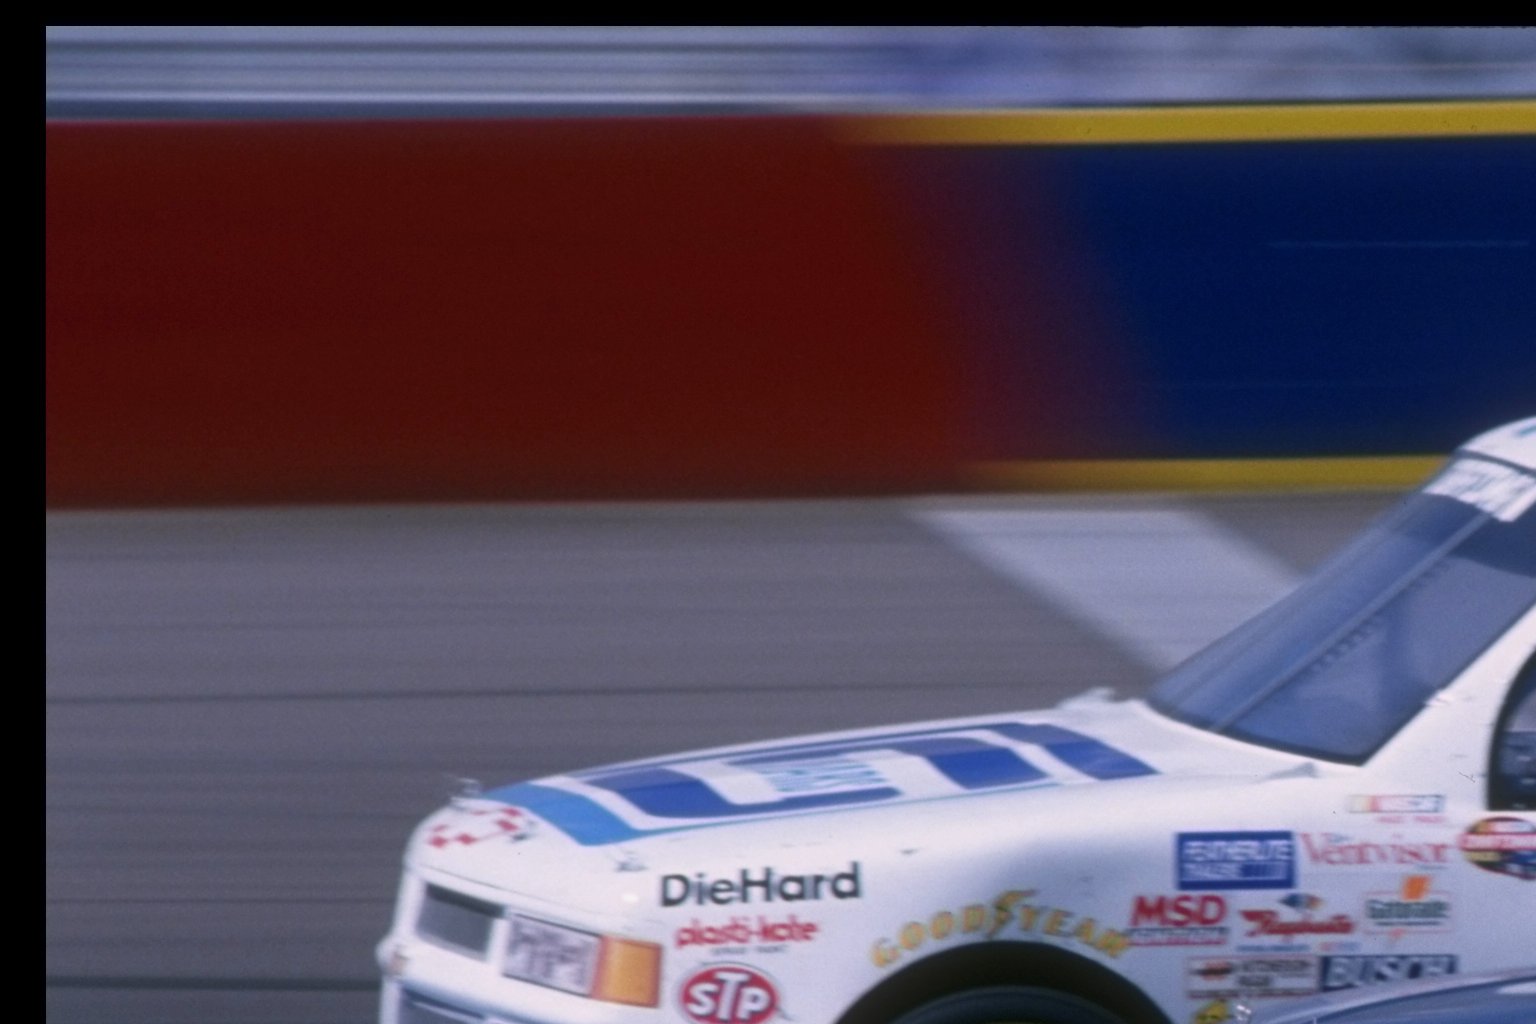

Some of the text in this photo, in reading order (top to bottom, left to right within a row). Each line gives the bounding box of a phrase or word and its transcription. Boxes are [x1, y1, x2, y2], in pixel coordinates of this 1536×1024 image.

[660, 860, 862, 907] DieHard
[1131, 894, 1228, 927] MSD
[687, 971, 773, 1024] STP
